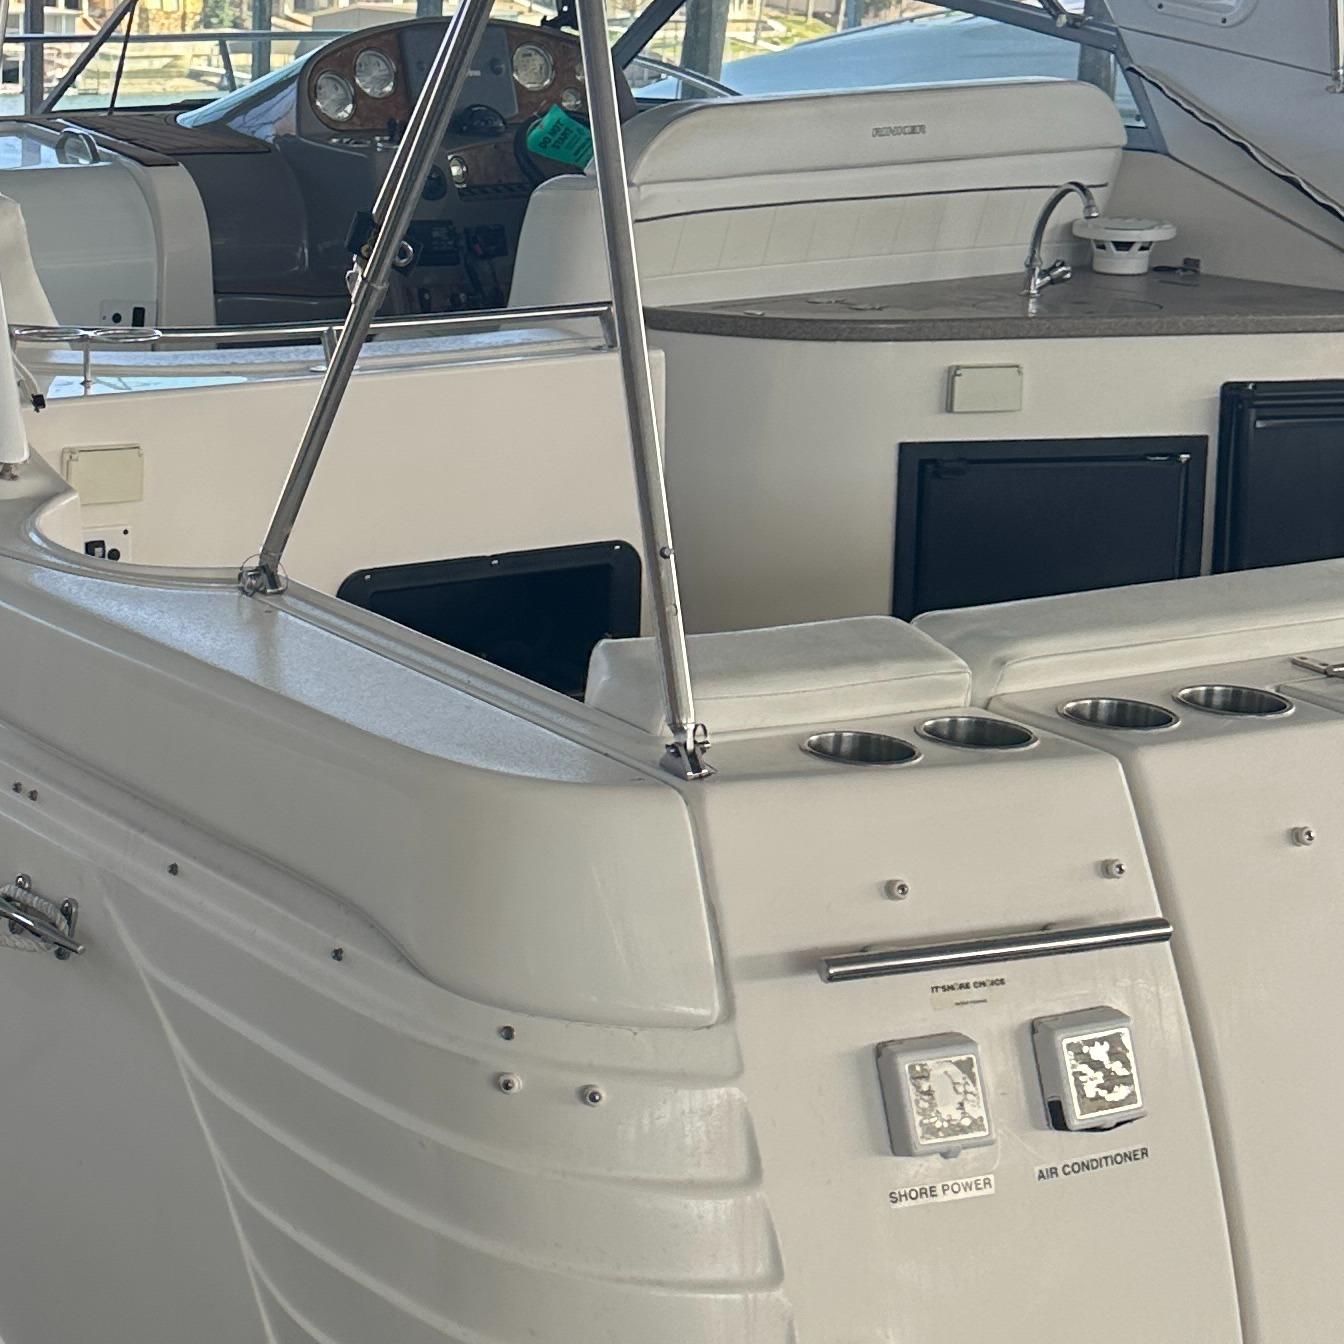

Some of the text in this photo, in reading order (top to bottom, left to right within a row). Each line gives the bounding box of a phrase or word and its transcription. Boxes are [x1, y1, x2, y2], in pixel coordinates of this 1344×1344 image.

[1037, 1147, 1150, 1182] AIR CONDITIONER
[889, 1177, 993, 1204] SHORE POWER
